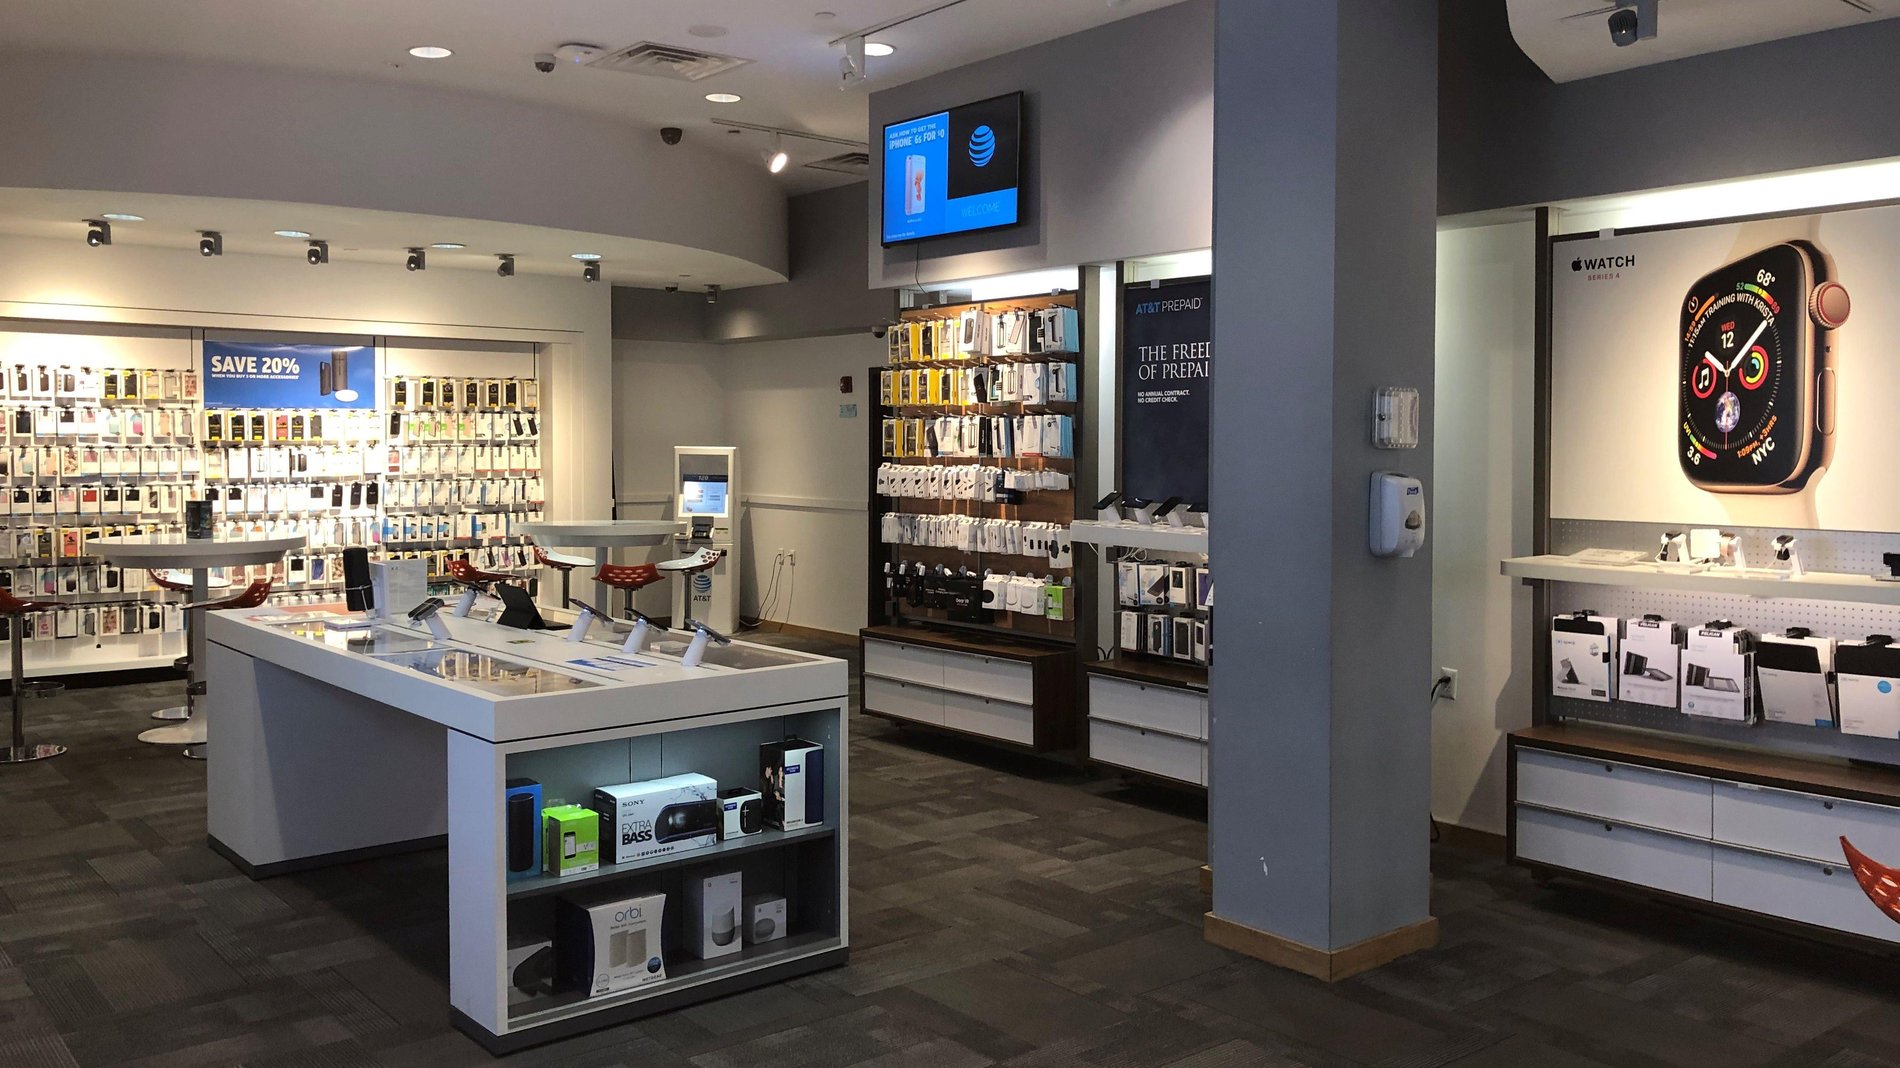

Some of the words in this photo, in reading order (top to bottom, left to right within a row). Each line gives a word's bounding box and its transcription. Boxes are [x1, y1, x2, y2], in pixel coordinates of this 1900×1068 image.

[889, 131, 899, 139] ASK
[899, 129, 911, 137] HOW
[917, 125, 927, 133] GET
[927, 123, 937, 131] THE
[923, 131, 937, 143] FOR
[960, 200, 1001, 217] WELCOME
[1584, 255, 1635, 270] WATCH
[1736, 282, 1744, 290] 52
[1135, 302, 1160, 315] AT&T
[1161, 297, 1203, 312] PREPAID
[1704, 293, 1736, 319] TRAINING
[1736, 292, 1755, 305] WITH
[1753, 298, 1775, 327] KRISTA
[1720, 321, 1736, 332] WED
[1720, 331, 1735, 349] 12
[1138, 345, 1167, 362] THE
[211, 355, 257, 373] SAVE
[261, 357, 300, 374] 20%
[1138, 364, 1157, 380] OF
[1687, 445, 1701, 465] 3.6
[1751, 437, 1775, 466] NYC
[622, 799, 645, 808] SONY
[621, 819, 653, 834] EXTRA
[622, 829, 653, 846] BASS
[615, 903, 642, 923] orbi
